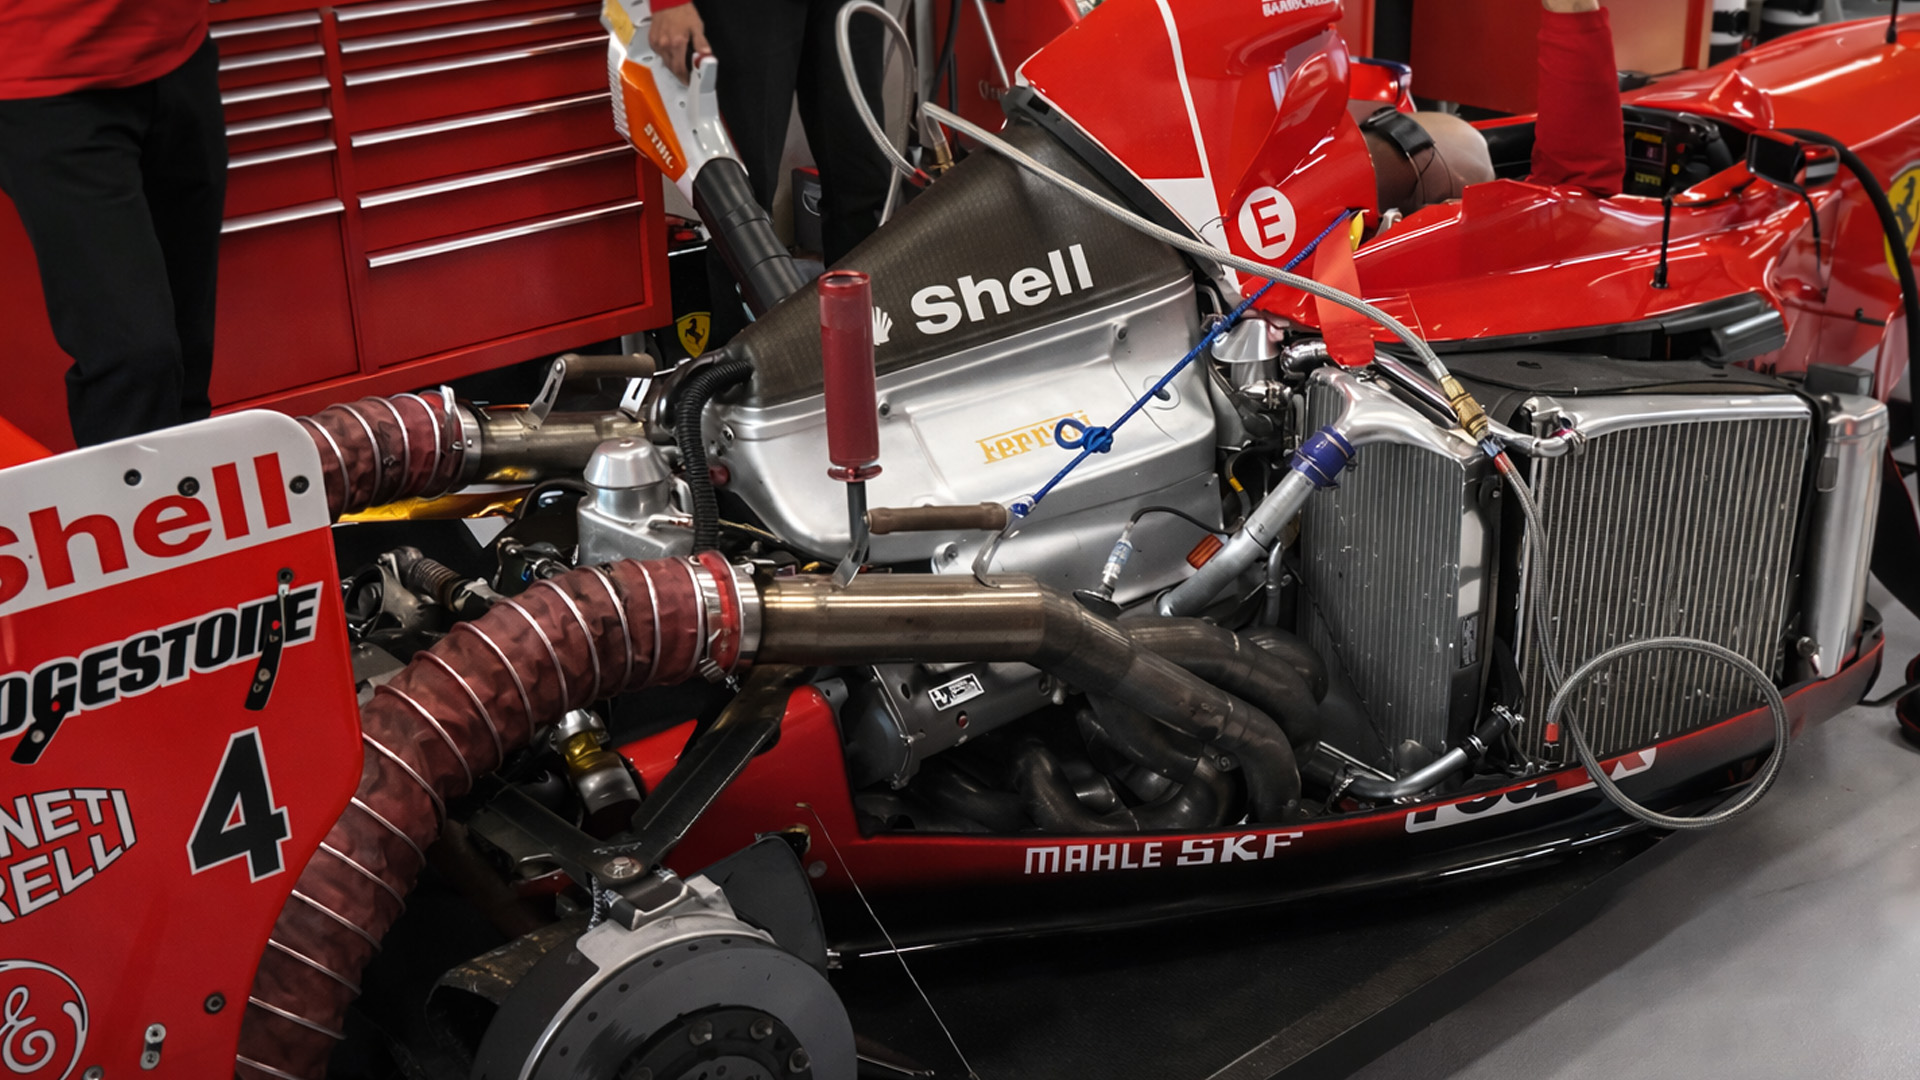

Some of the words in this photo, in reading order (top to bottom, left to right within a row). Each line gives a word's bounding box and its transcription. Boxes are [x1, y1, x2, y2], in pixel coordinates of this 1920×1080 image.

[1250, 197, 1286, 248] E
[911, 244, 1093, 334] Shell
[976, 411, 1092, 464] Ferr
[187, 727, 291, 883] 4
[1024, 842, 1162, 874] MAHLE
[1177, 831, 1303, 866] SKF
